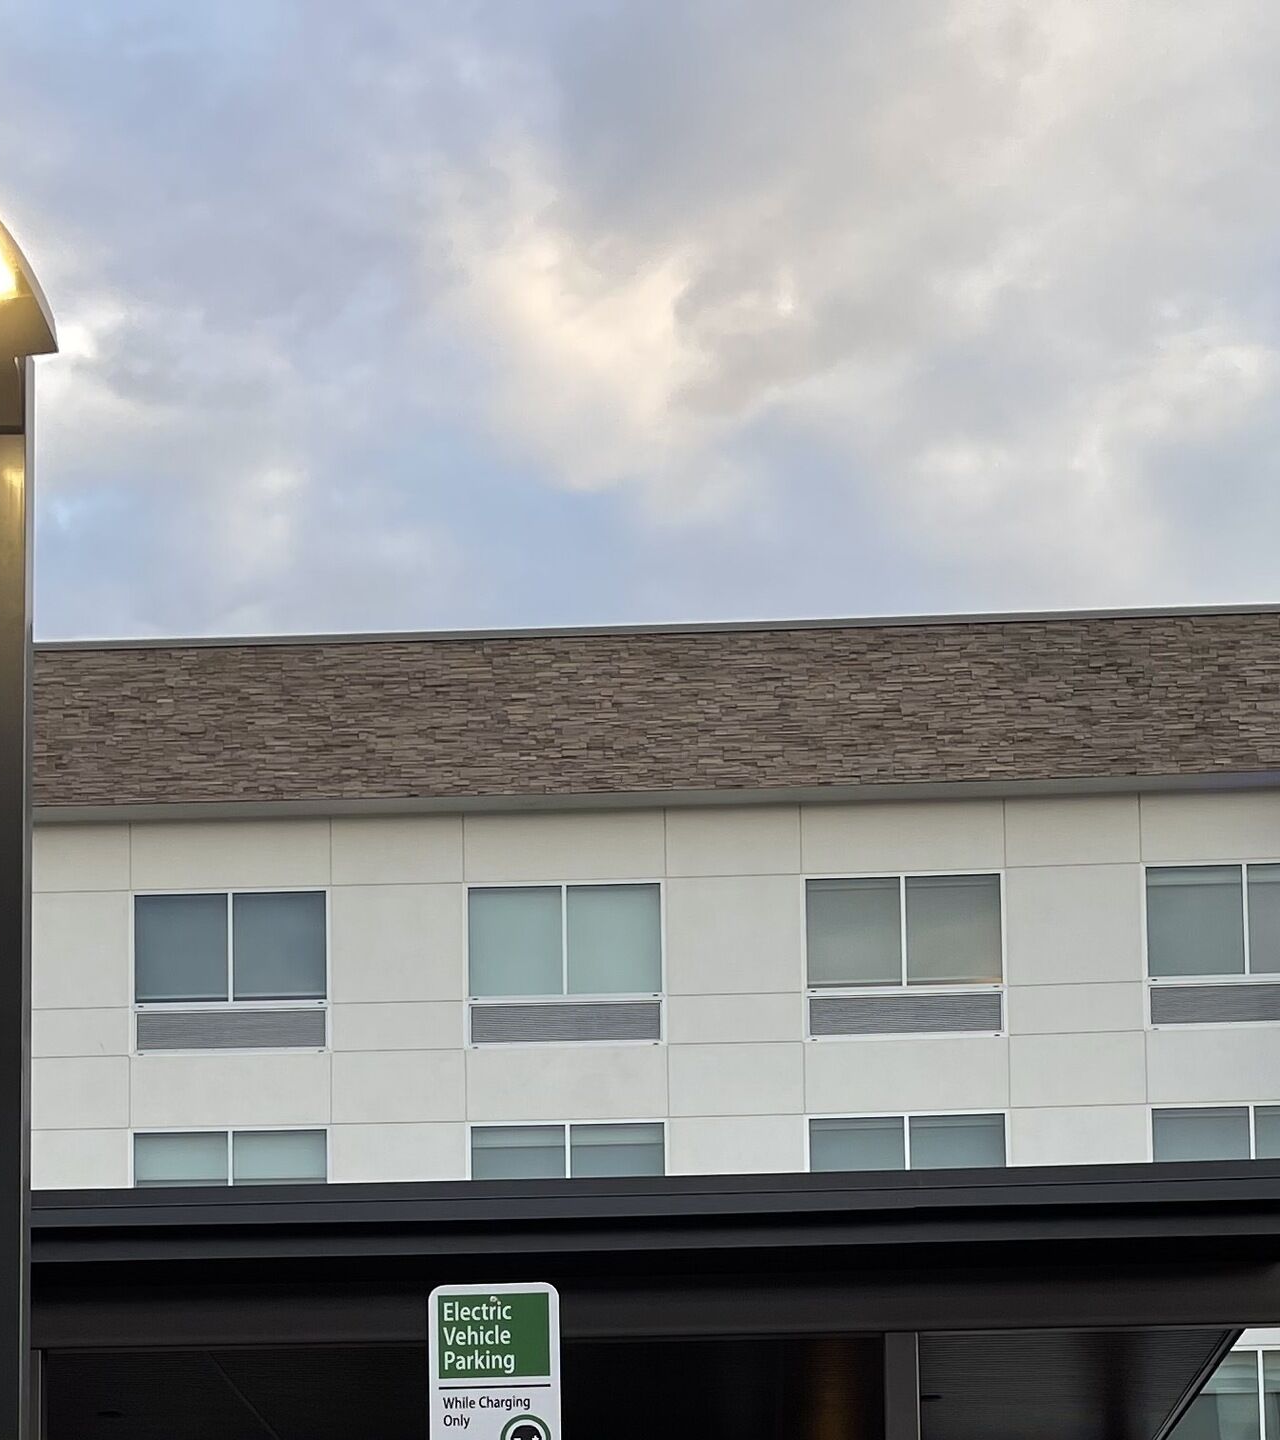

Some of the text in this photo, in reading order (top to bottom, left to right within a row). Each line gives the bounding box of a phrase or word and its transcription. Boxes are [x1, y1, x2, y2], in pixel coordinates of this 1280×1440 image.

[443, 1300, 512, 1321] Electric
[443, 1325, 511, 1346] Vehicle
[444, 1350, 516, 1374] Parking
[443, 1395, 531, 1411] While Charging
[443, 1414, 470, 1429] Only
